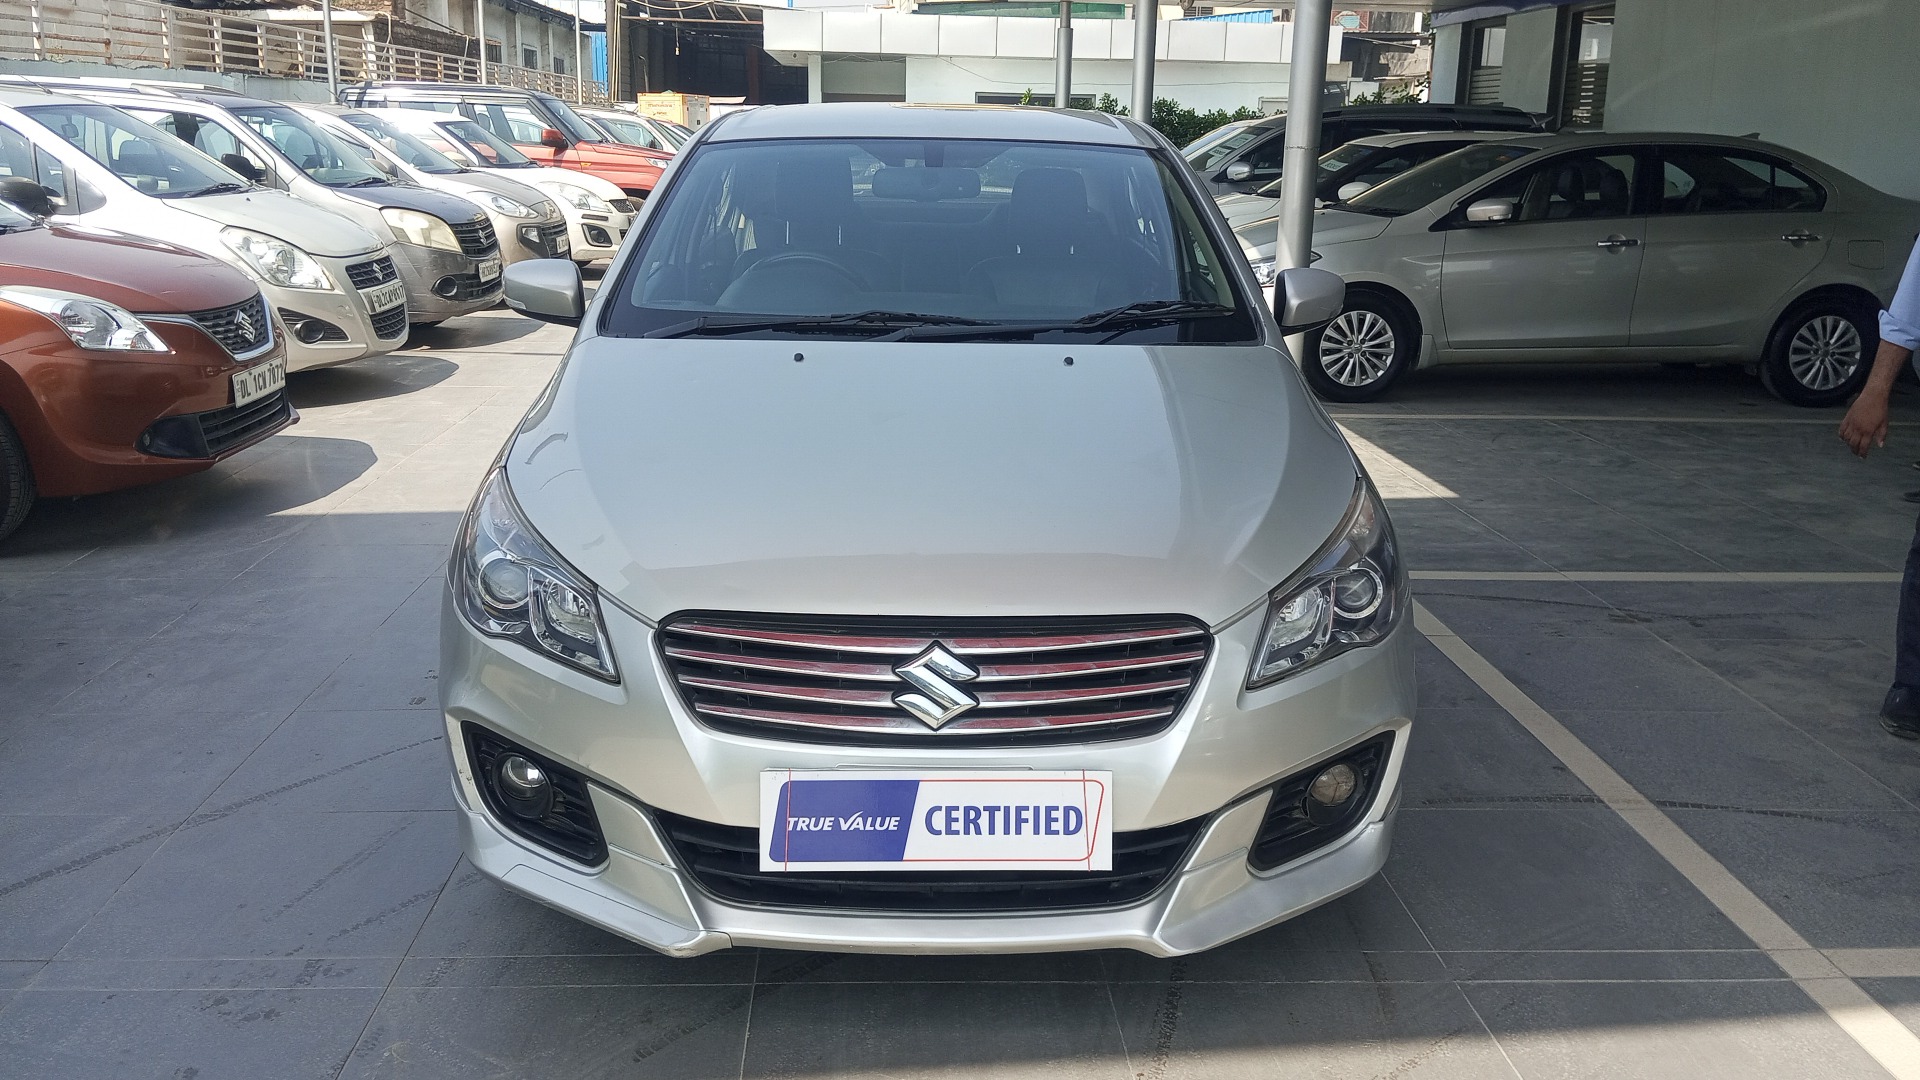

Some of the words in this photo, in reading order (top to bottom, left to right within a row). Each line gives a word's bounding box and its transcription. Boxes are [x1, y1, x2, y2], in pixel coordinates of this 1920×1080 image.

[240, 378, 251, 399] DL
[787, 816, 835, 831] TRUE
[838, 811, 901, 831] VALUE
[924, 805, 1083, 836] CERTIFIED
